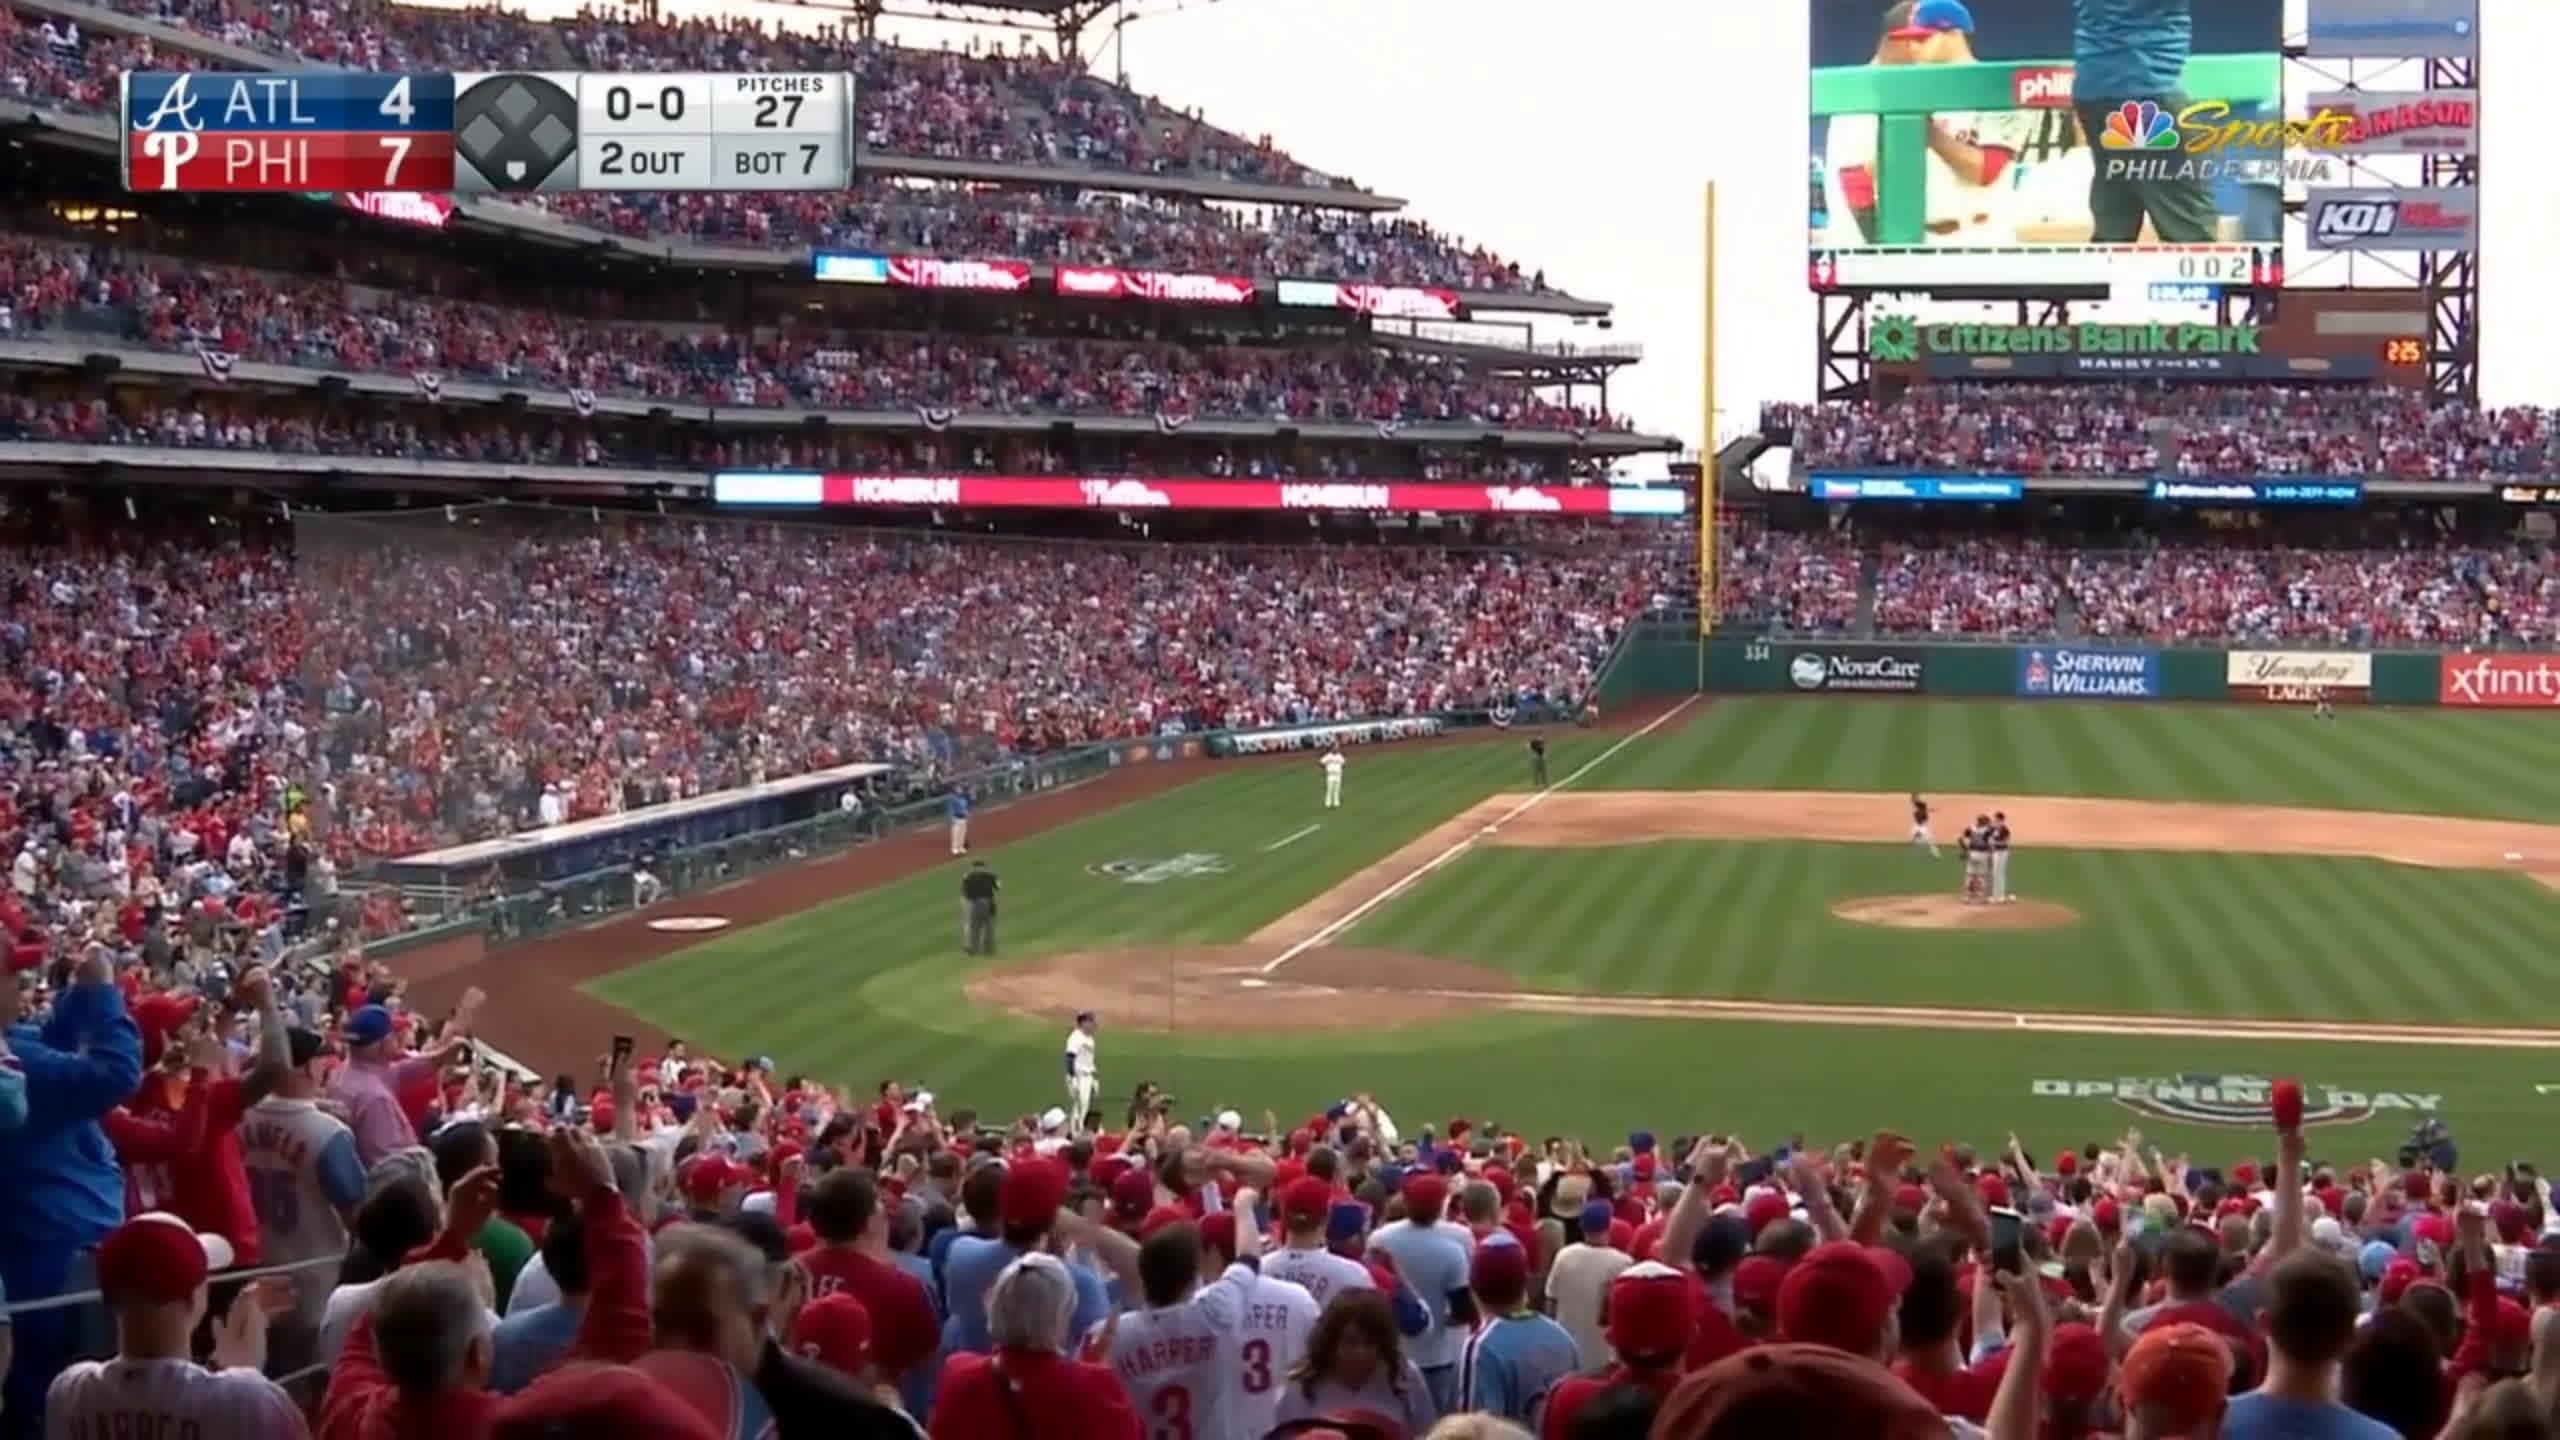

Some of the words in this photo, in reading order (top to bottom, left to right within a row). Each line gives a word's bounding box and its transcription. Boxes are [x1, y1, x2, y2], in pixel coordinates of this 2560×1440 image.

[1928, 322, 2072, 352] Citizens
[2080, 320, 2170, 352] Bank
[2177, 320, 2259, 353] Park
[1828, 656, 1920, 677] NovaCare
[2054, 653, 2145, 672] SHERWIN
[2052, 672, 2148, 695] WILLIAMS
[2032, 1079, 2307, 1102] OPENIN
[2326, 1090, 2441, 1110] DAY
[1117, 1336, 1215, 1377] HARPER
[1241, 1338, 1272, 1394] 3
